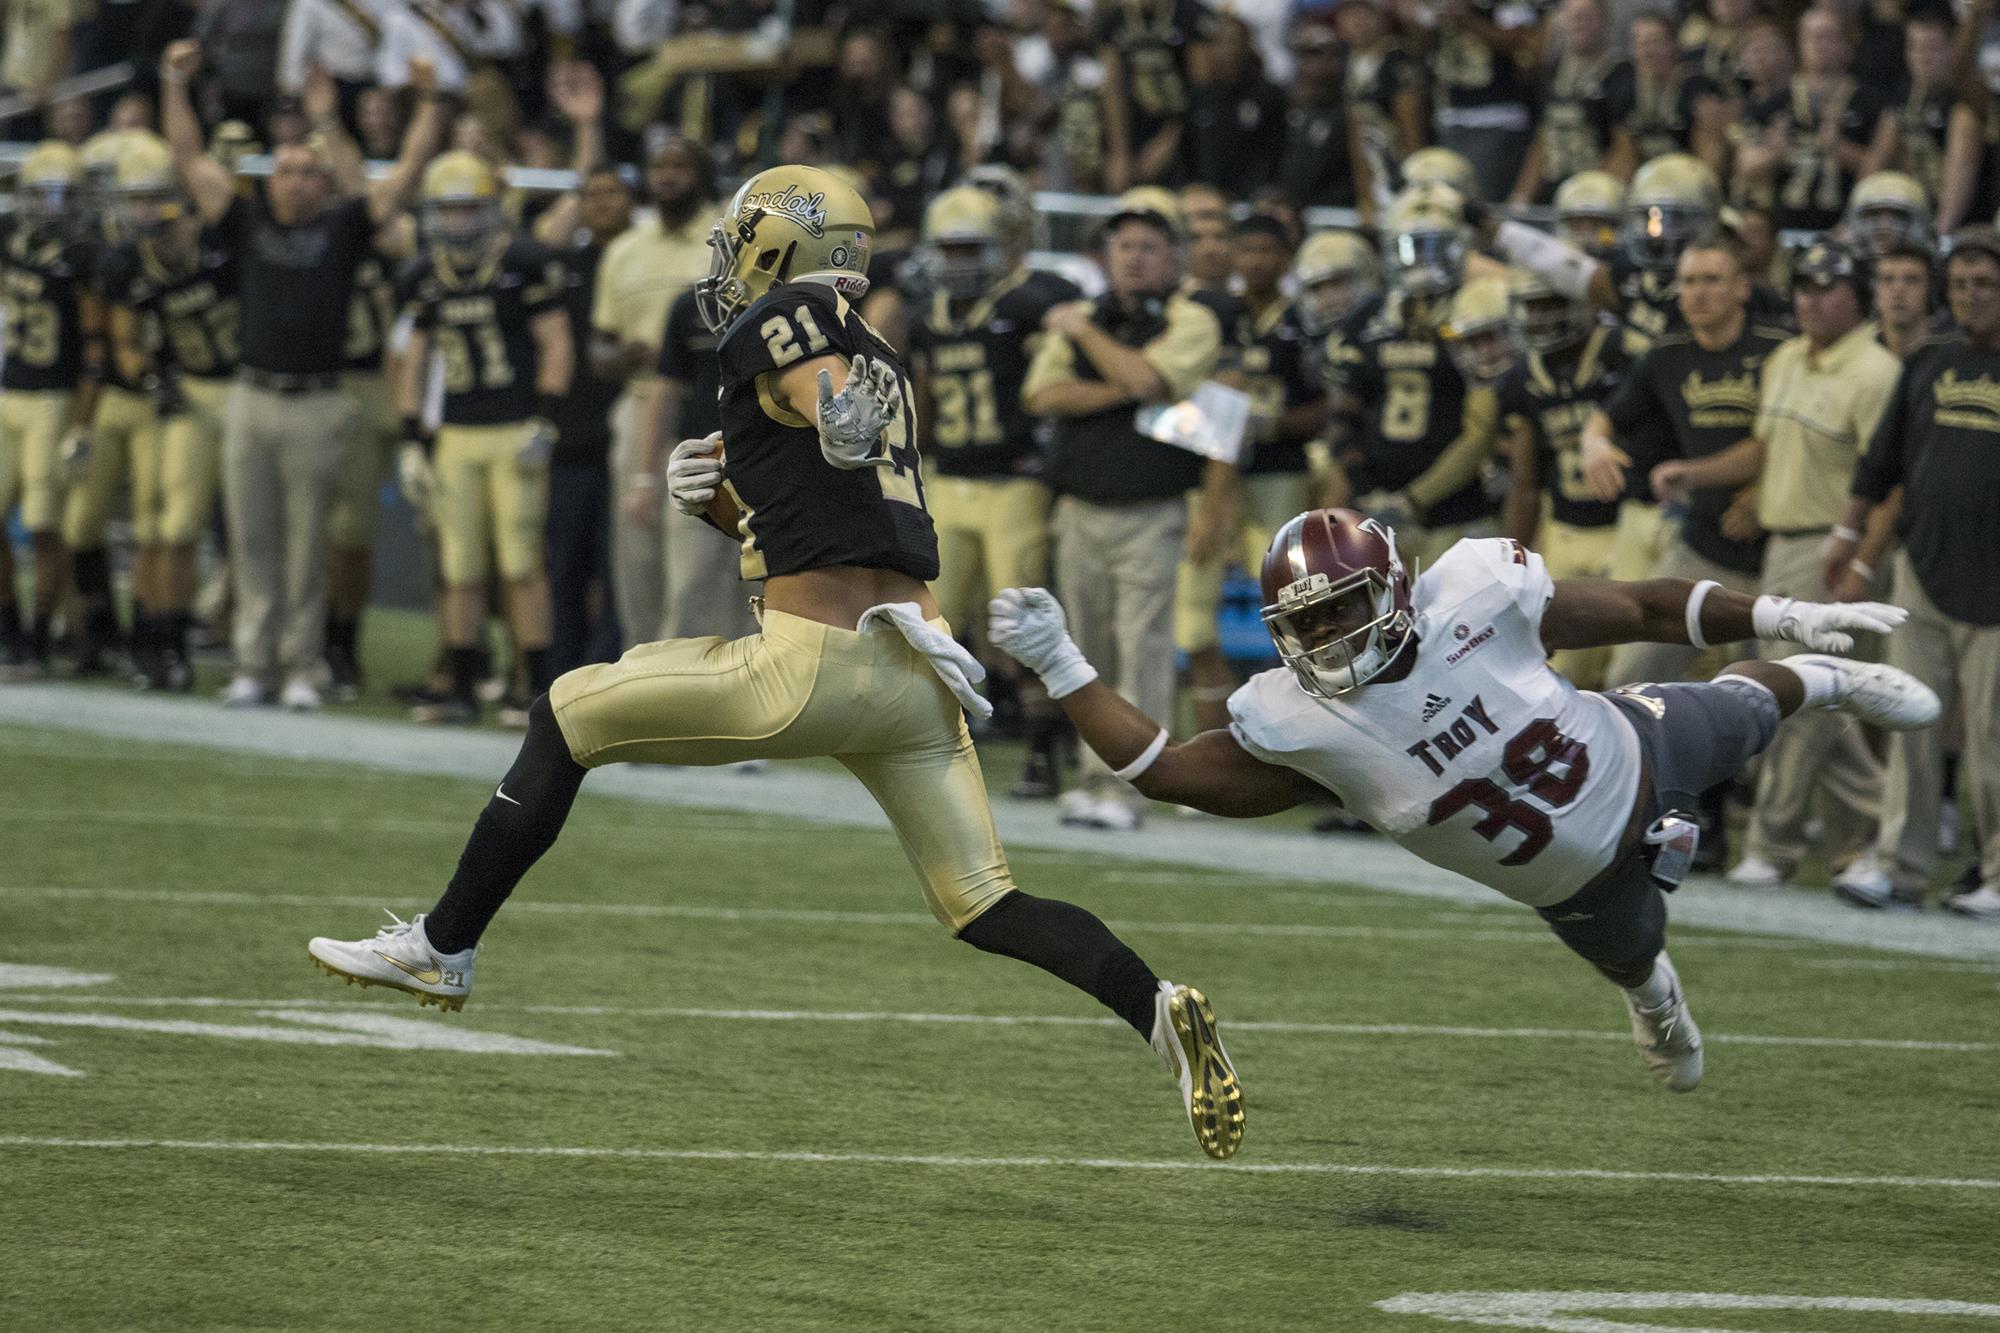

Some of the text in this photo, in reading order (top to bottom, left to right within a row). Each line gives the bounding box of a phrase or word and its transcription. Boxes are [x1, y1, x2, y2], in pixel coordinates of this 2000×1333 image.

[741, 185, 827, 228] andals
[760, 305, 829, 368] 21
[1406, 694, 1500, 777] TROY
[1427, 718, 1590, 866] 38
[444, 970, 465, 988] 21
